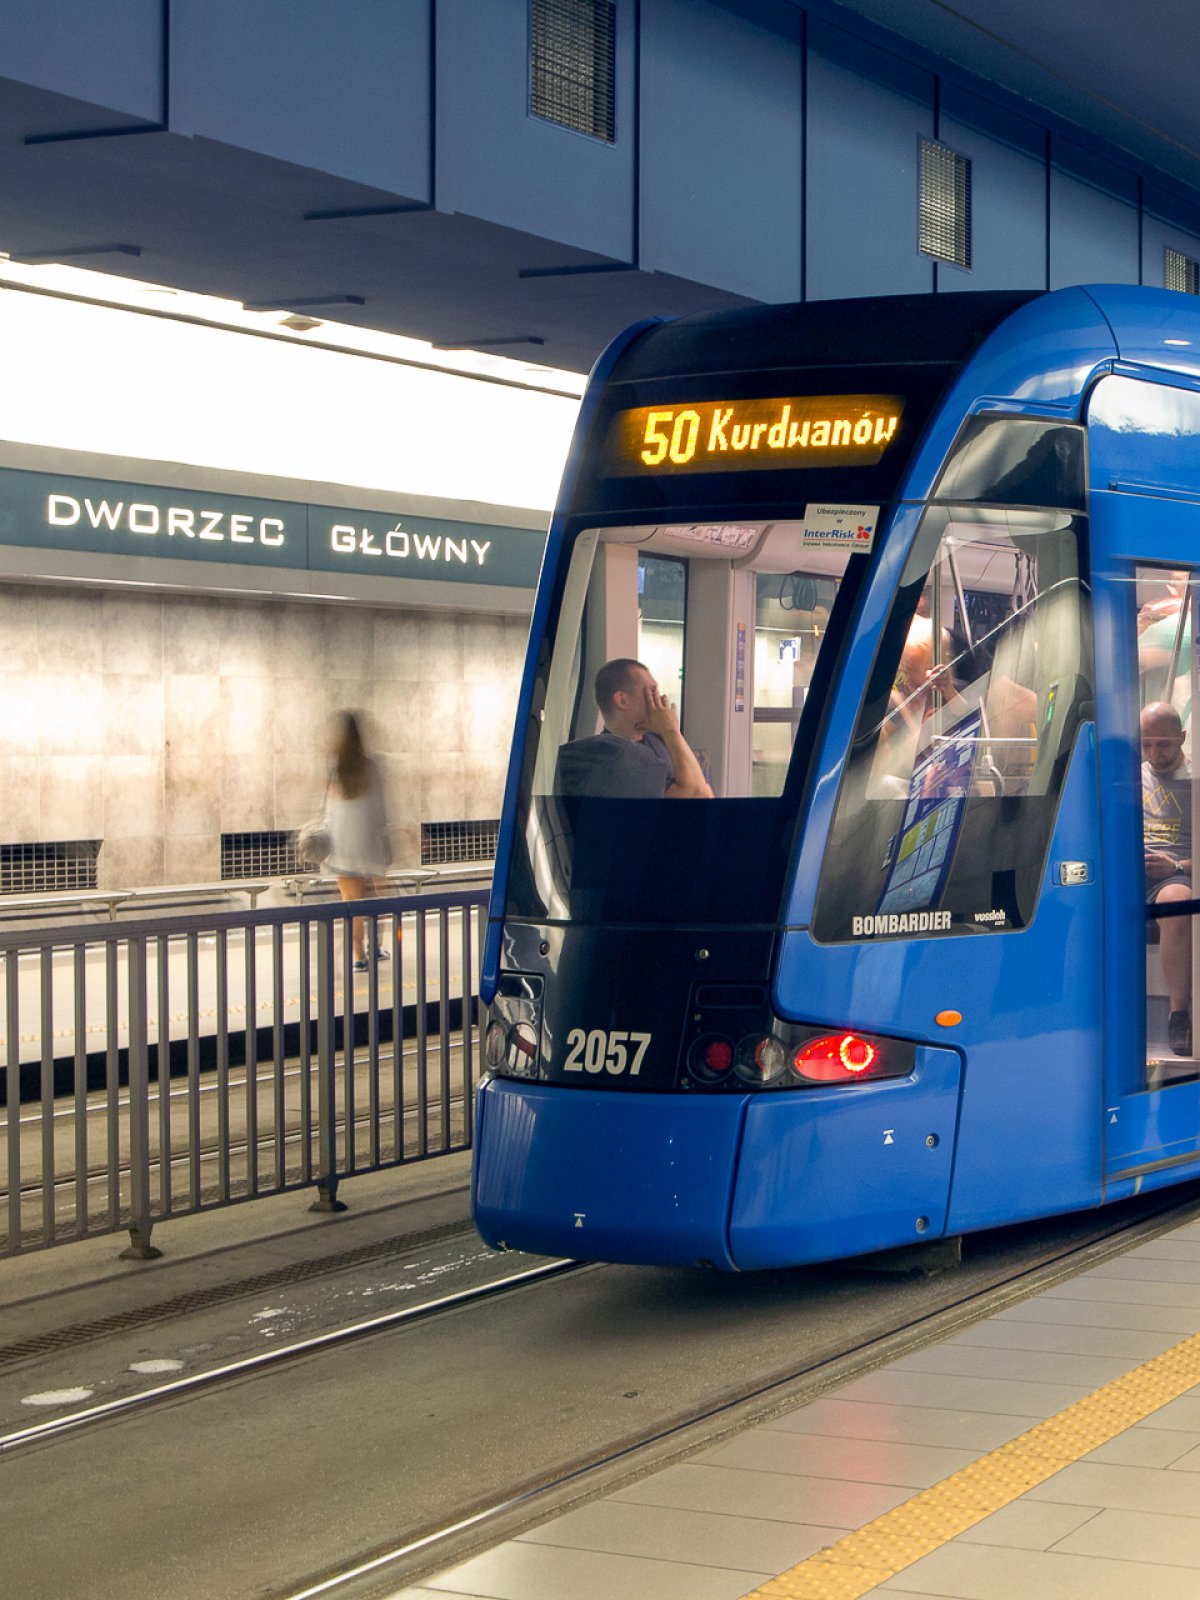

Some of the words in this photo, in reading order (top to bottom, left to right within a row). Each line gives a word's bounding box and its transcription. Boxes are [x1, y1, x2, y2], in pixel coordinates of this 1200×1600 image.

[641, 410, 701, 466] 50
[707, 404, 898, 452] Kurdwanów
[48, 494, 285, 546] DWORZEC
[331, 522, 491, 566] GŁÓWNY
[816, 508, 867, 516] Ubezpieczony
[804, 528, 854, 539] InterRisk
[852, 911, 951, 936] BOMBARDIER
[563, 1028, 652, 1076] 2057
